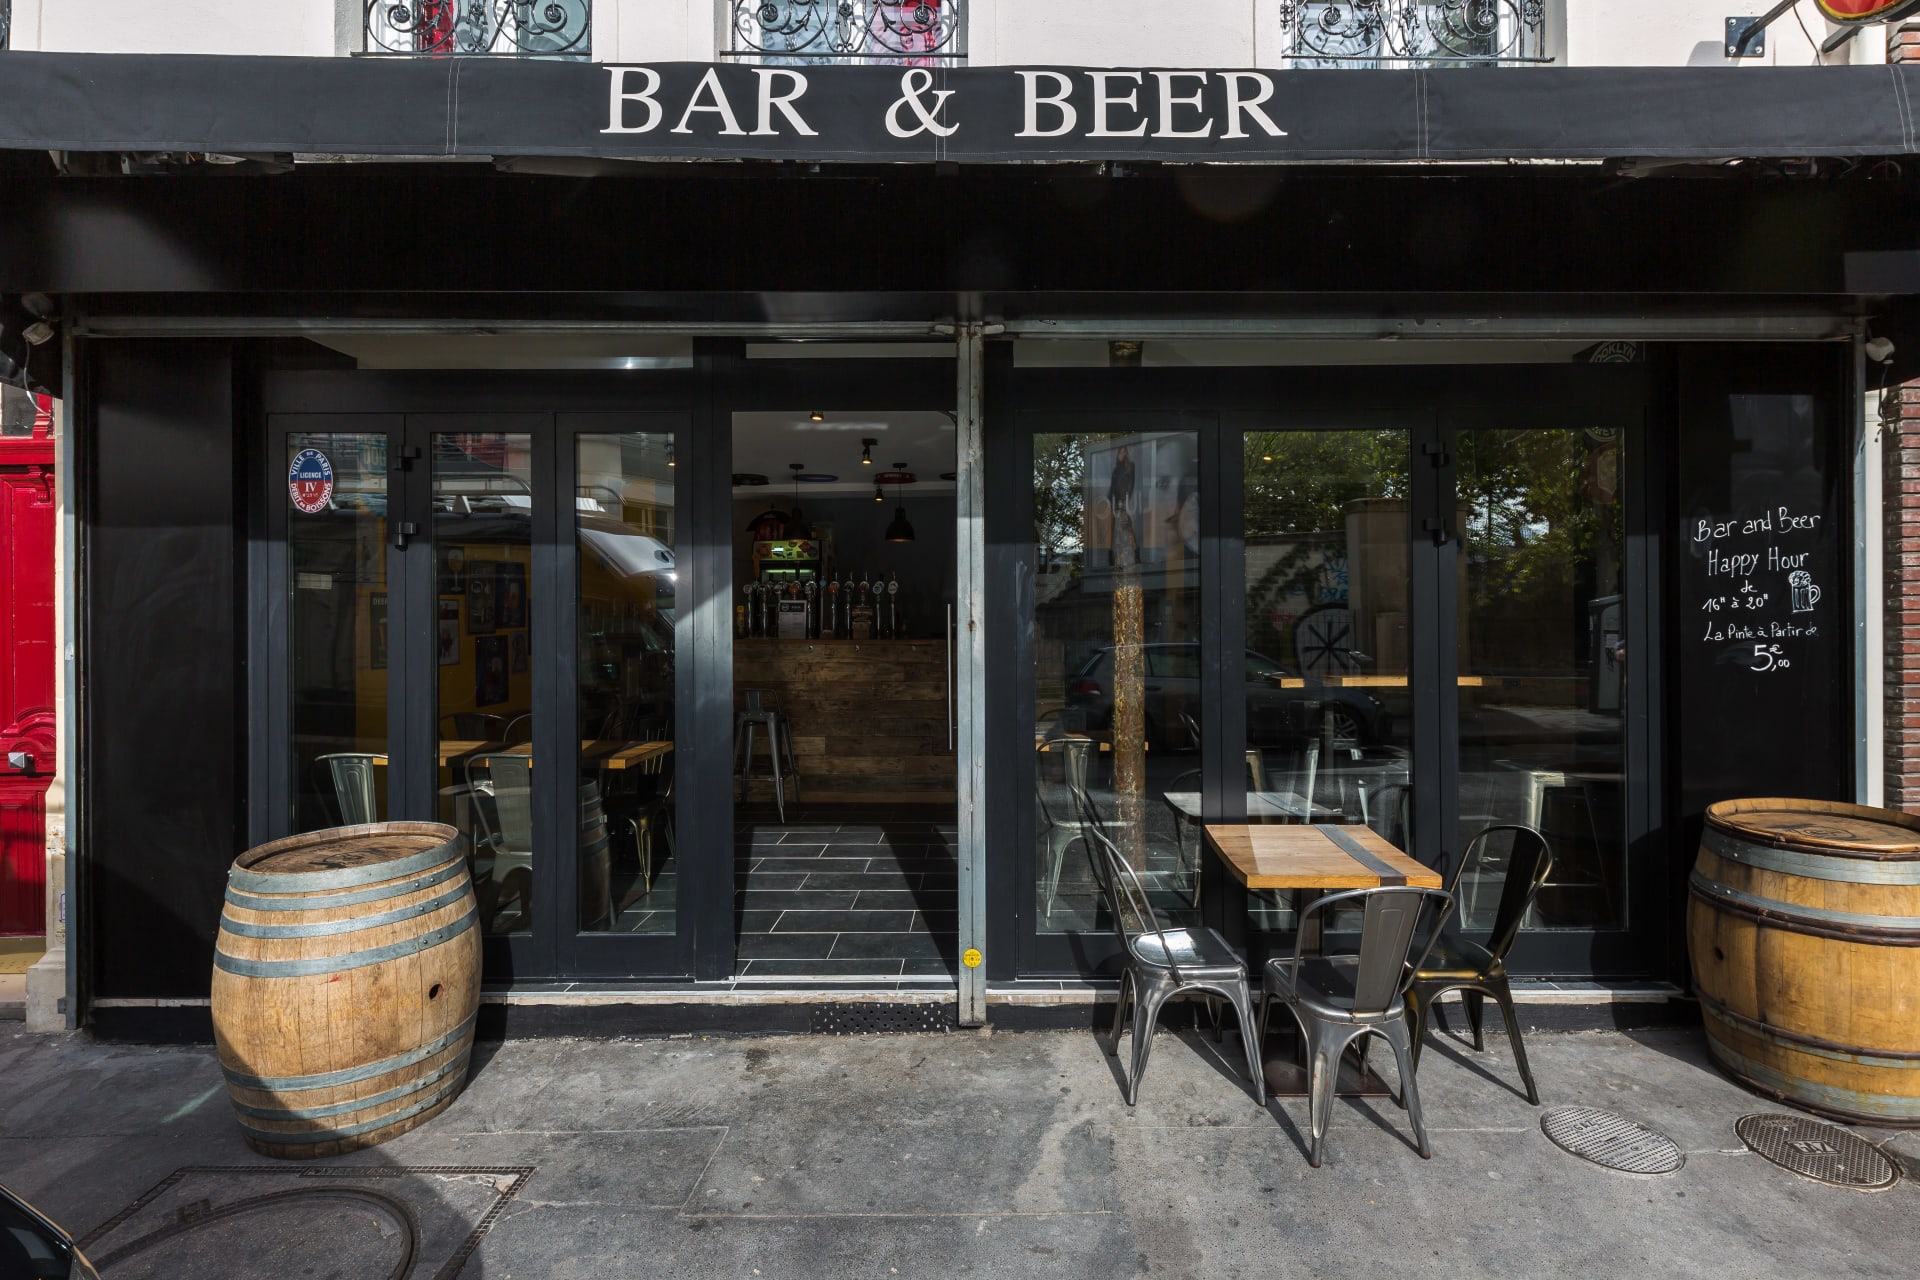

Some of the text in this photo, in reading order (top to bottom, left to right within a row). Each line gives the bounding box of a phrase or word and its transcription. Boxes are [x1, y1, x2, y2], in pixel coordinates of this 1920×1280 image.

[600, 66, 1288, 139] BAR & BEER
[1594, 342, 1636, 362] OOKLYN
[291, 455, 305, 476] VILLE
[315, 454, 331, 476] PARIS
[305, 482, 317, 492] IV
[306, 482, 332, 511] BOISSONS
[1693, 506, 1821, 542] Bar and Beer
[1708, 546, 1809, 578] Happy Hour
[1740, 579, 1758, 593] de
[1703, 621, 1725, 641] La
[1728, 623, 1756, 639] Pinte
[1757, 626, 1768, 638] à
[1770, 621, 1804, 638] Partir
